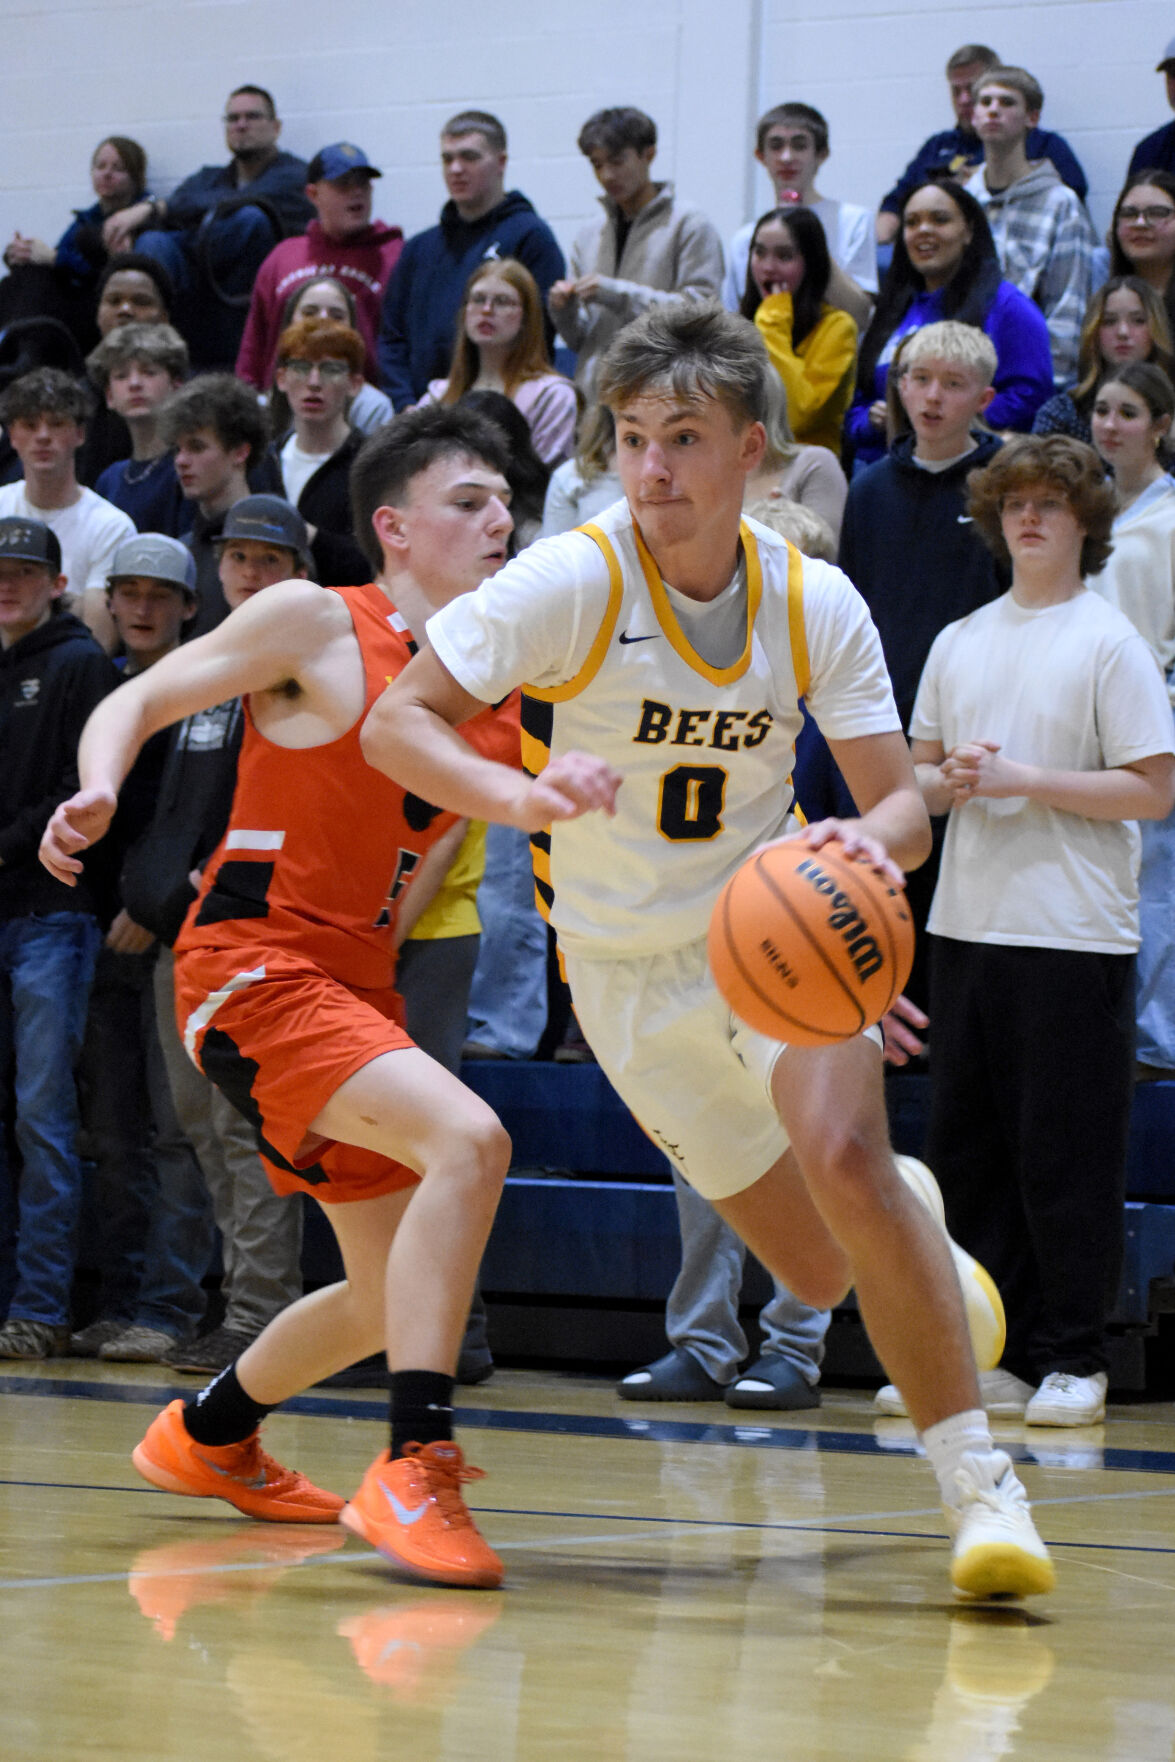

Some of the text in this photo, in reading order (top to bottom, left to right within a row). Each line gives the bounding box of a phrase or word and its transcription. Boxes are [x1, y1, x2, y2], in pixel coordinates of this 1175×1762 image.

[633, 698, 773, 752] BEES
[656, 762, 729, 843] 0
[795, 858, 884, 985] Wilson
